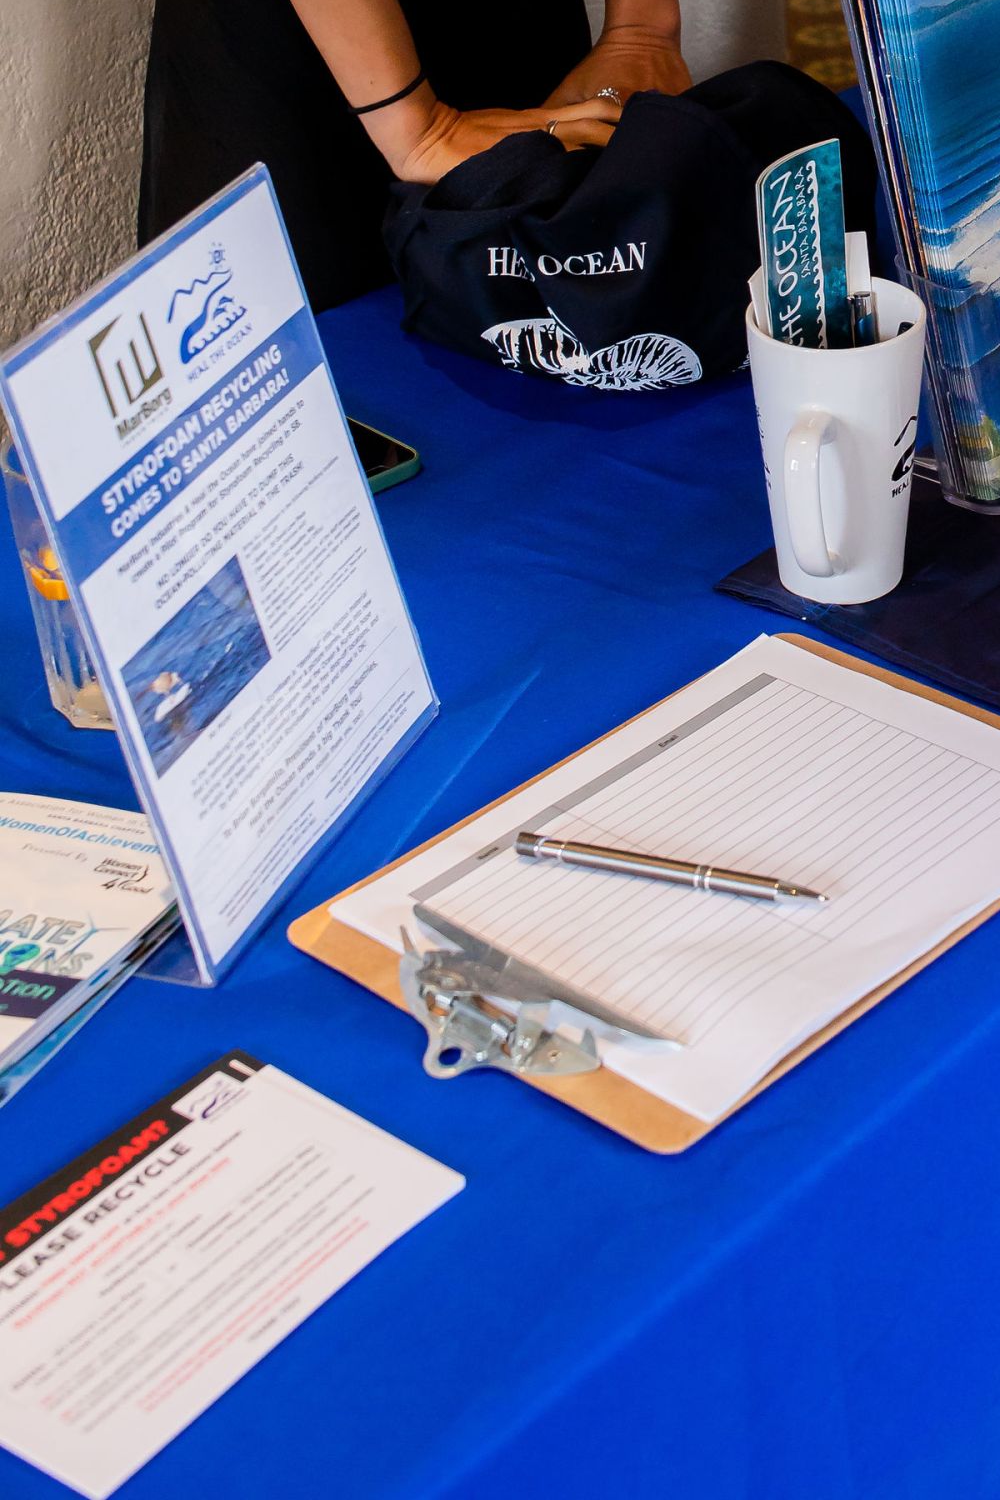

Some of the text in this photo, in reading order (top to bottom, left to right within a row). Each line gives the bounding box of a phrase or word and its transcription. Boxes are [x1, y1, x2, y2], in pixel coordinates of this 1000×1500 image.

[537, 242, 647, 276] OCEAN
[770, 170, 799, 298] OCEAN
[794, 166, 812, 278] SANTA BARBARA
[116, 383, 173, 443] MarBorg
[186, 321, 252, 385] HEAL THE OCEAN
[100, 412, 202, 517] STYROFOAM
[200, 341, 282, 428] RECYCLING
[109, 481, 162, 542] COMES
[160, 462, 183, 495] TO
[179, 422, 227, 477] SANTA
[224, 365, 290, 436] BARBARA!
[102, 857, 143, 871] Women
[0, 1226, 83, 1292] LEASE
[85, 1142, 191, 1228] RECYCLE
[5, 1119, 171, 1248] STYROFOAM?
